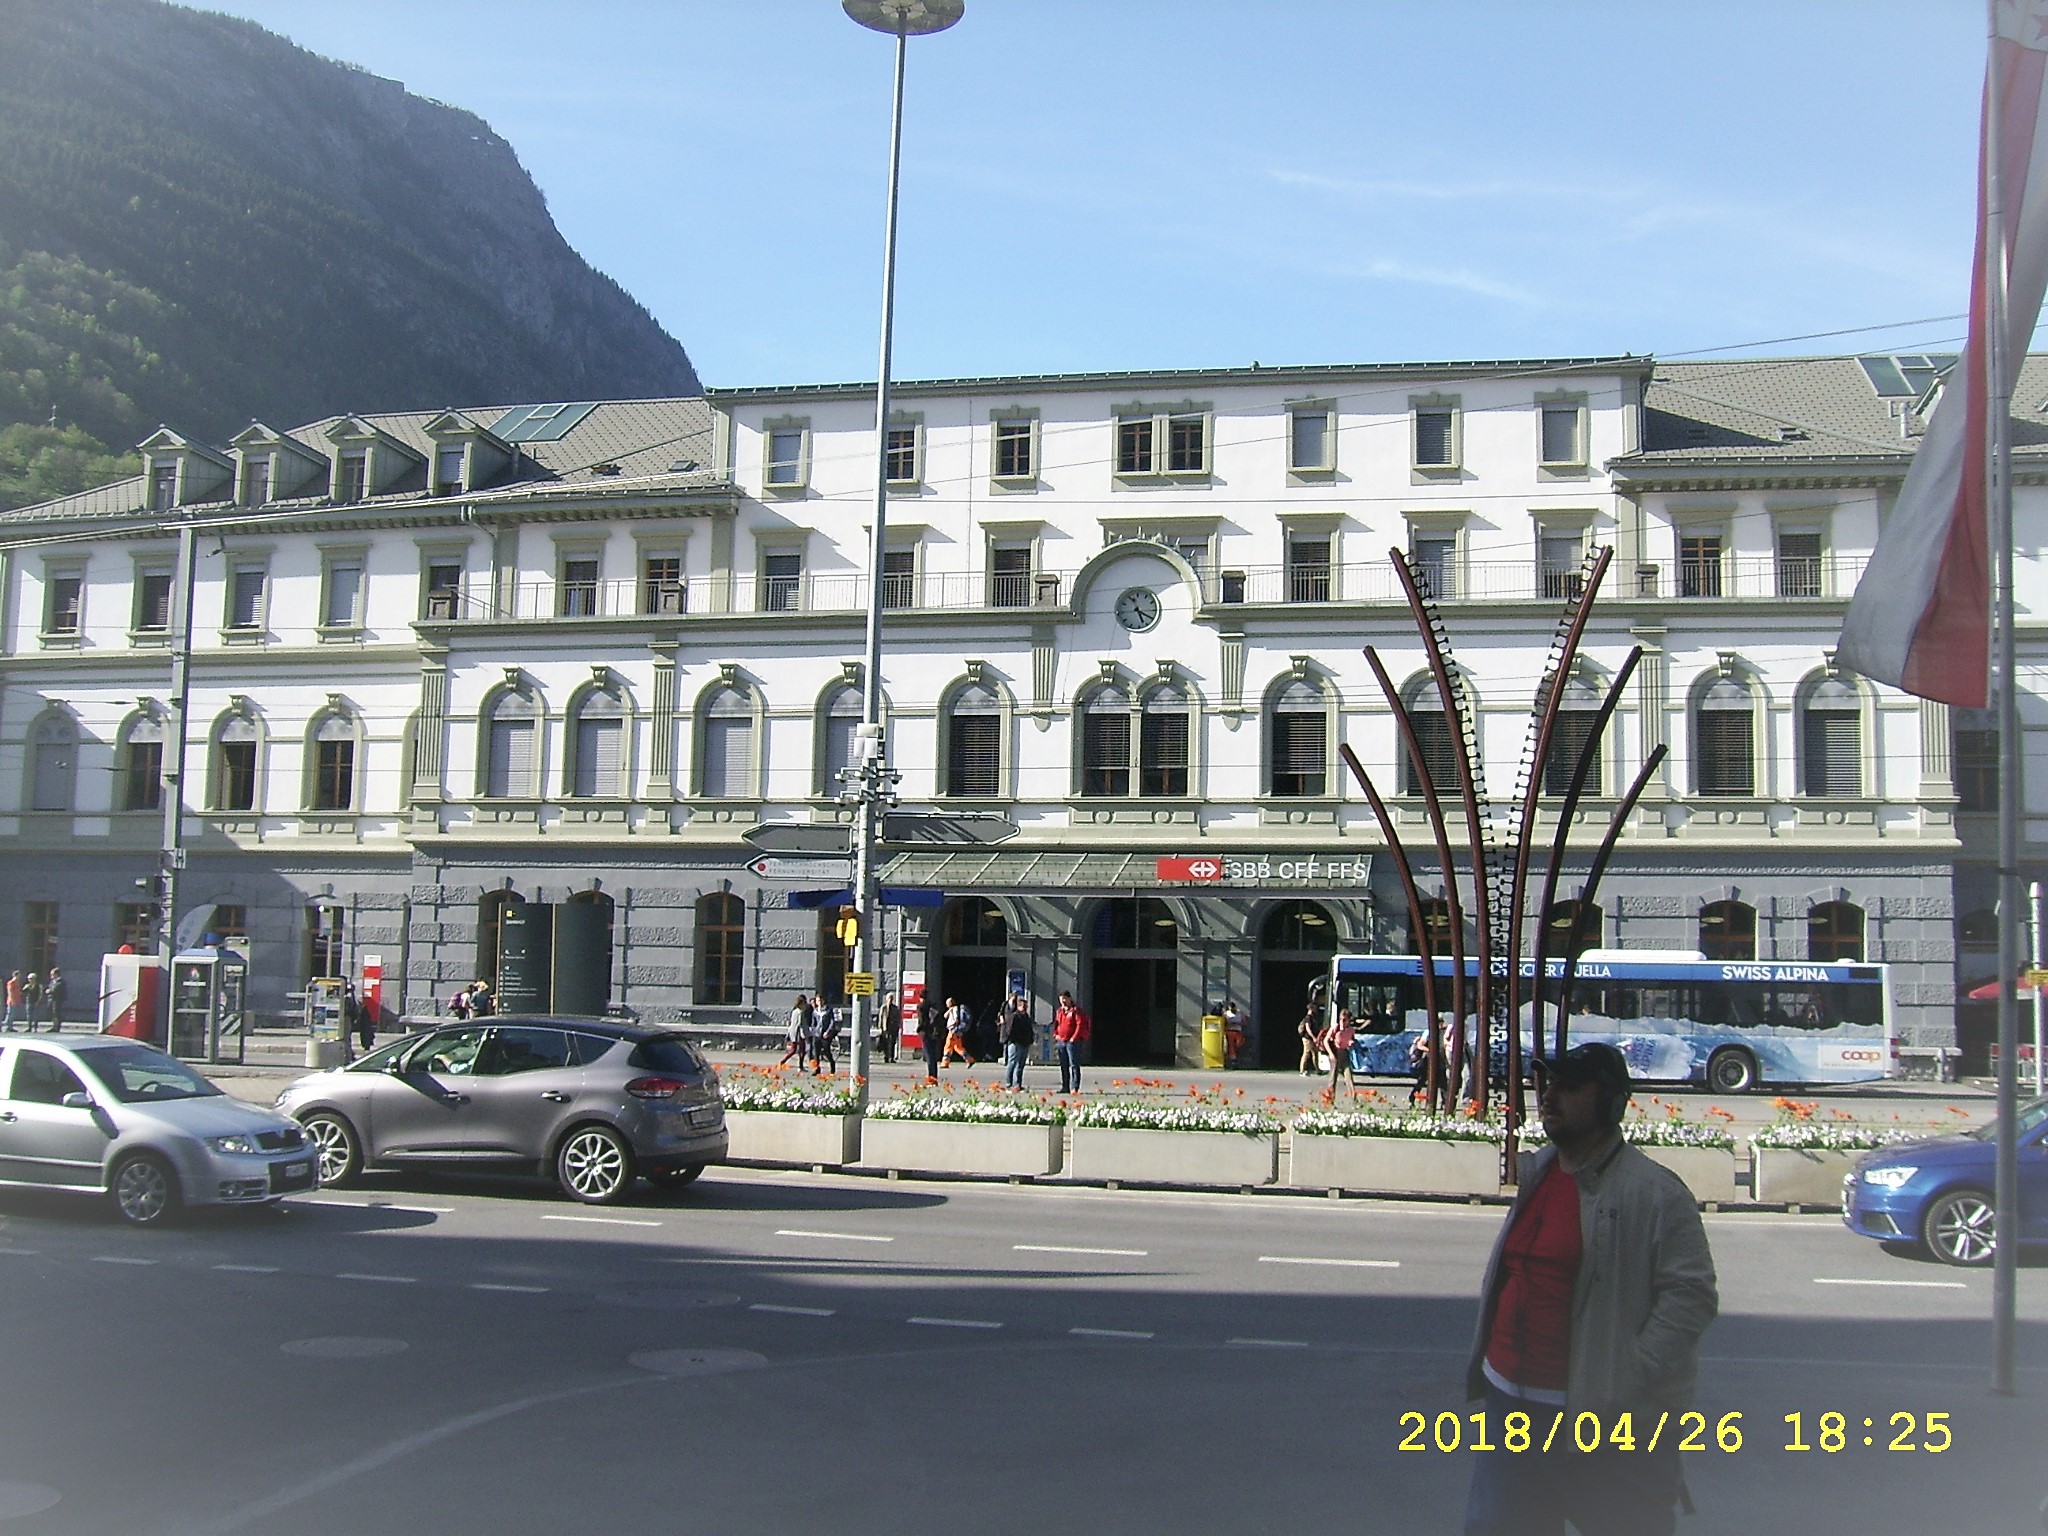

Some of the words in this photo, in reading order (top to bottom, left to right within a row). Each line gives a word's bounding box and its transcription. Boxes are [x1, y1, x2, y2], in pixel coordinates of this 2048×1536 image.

[1230, 861, 1271, 879] SBB
[1278, 861, 1319, 879] CFF
[1327, 861, 1366, 879] FFS
[1722, 965, 1772, 981] SWISS
[1775, 966, 1829, 982] ALPINA
[1841, 1050, 1881, 1063] coop
